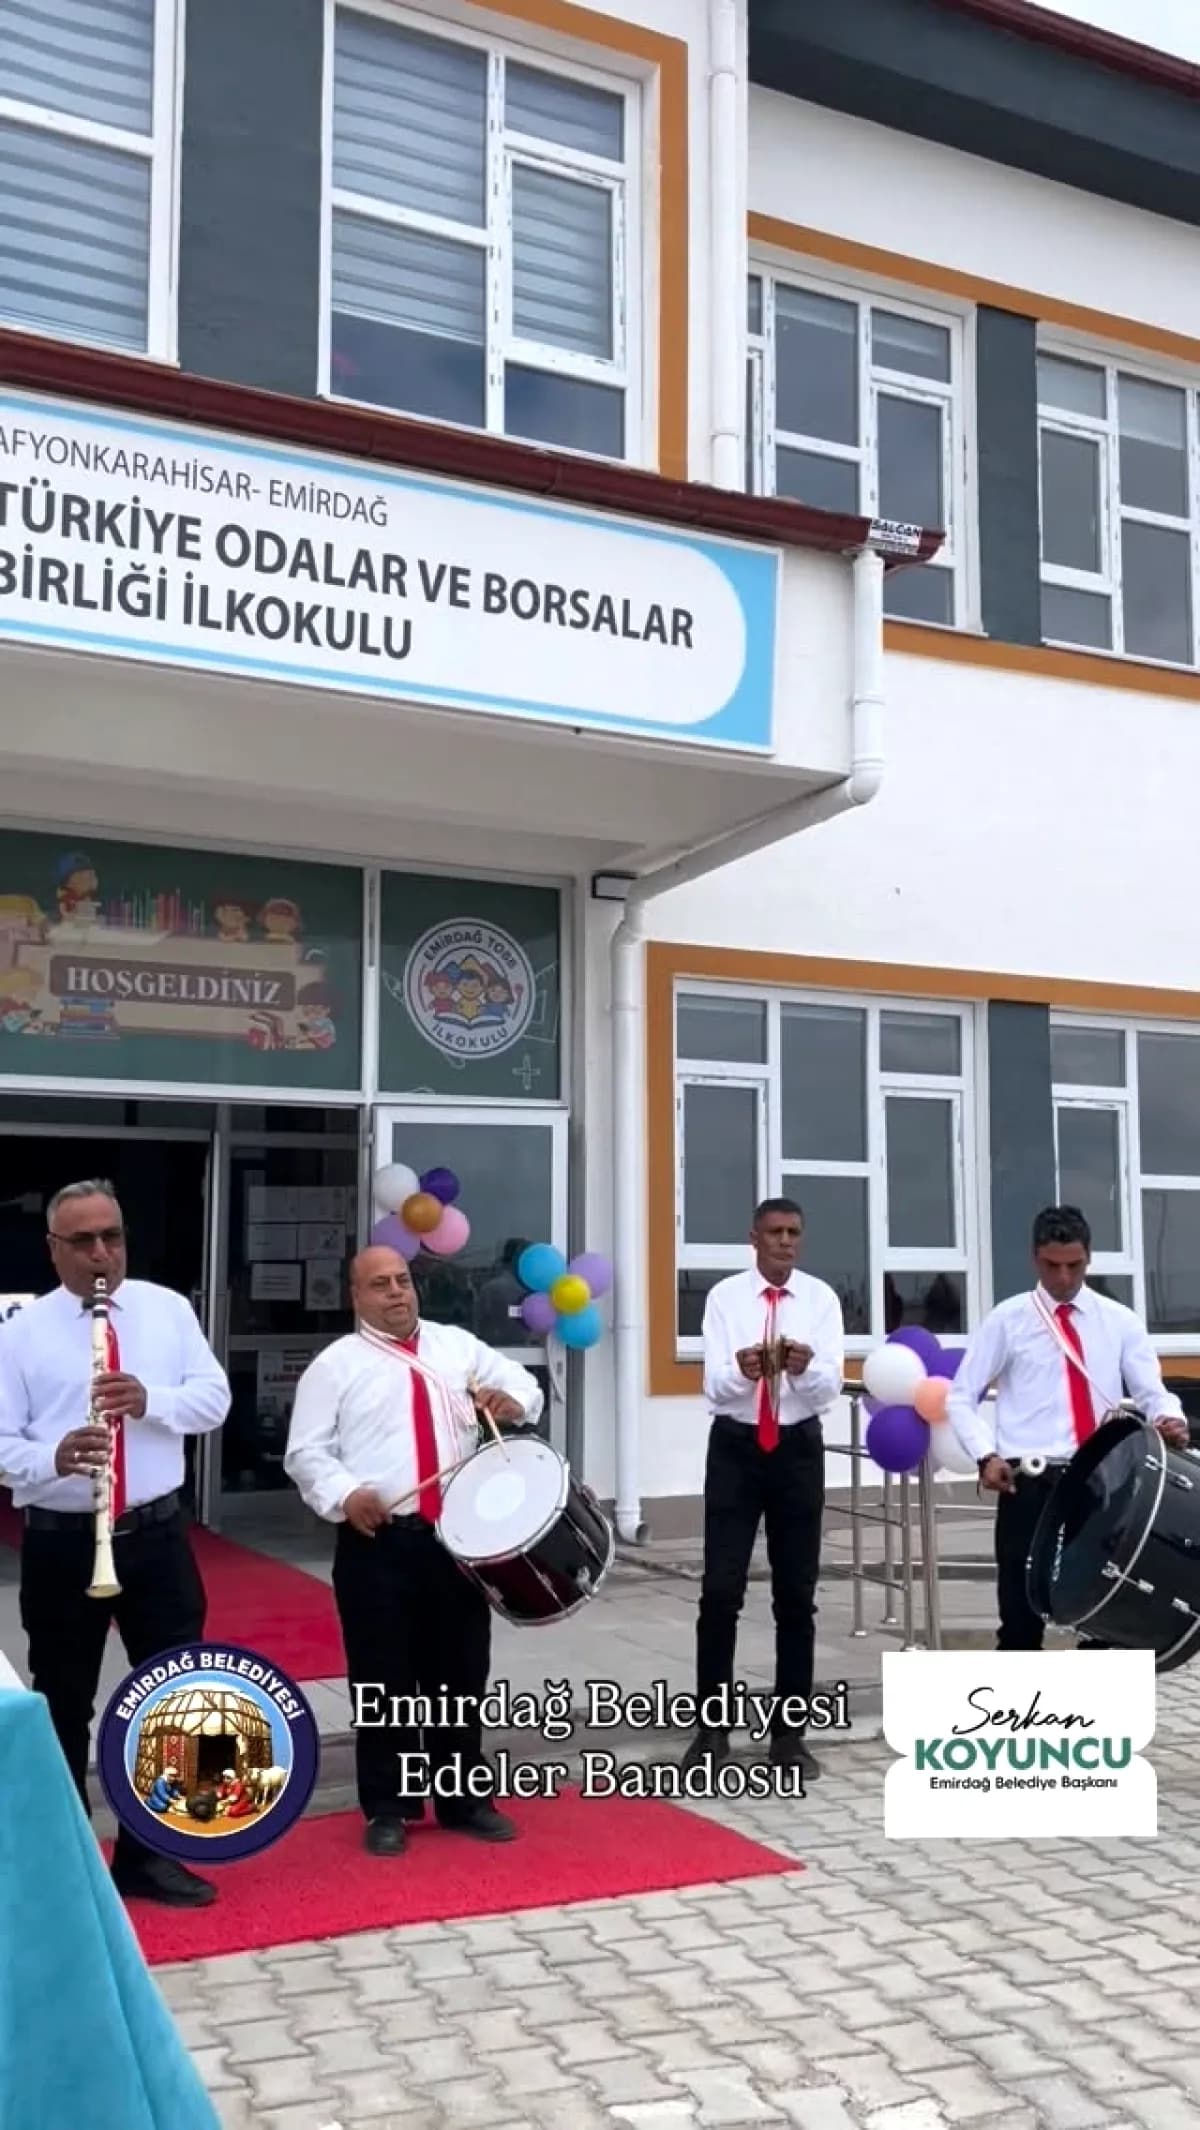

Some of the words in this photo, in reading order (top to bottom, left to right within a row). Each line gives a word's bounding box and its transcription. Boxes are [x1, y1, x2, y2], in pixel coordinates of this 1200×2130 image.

[269, 479, 388, 526] EMİRDAĞ
[0, 476, 201, 561] TÜRKİYE
[215, 523, 408, 598] ODALAR
[418, 558, 471, 609] VE
[483, 572, 693, 649] BORSALAR
[0, 544, 167, 620] BİRLİĞİ
[183, 571, 412, 660] İLKOKULU
[67, 966, 282, 1004] HOŞGELDİNİZ
